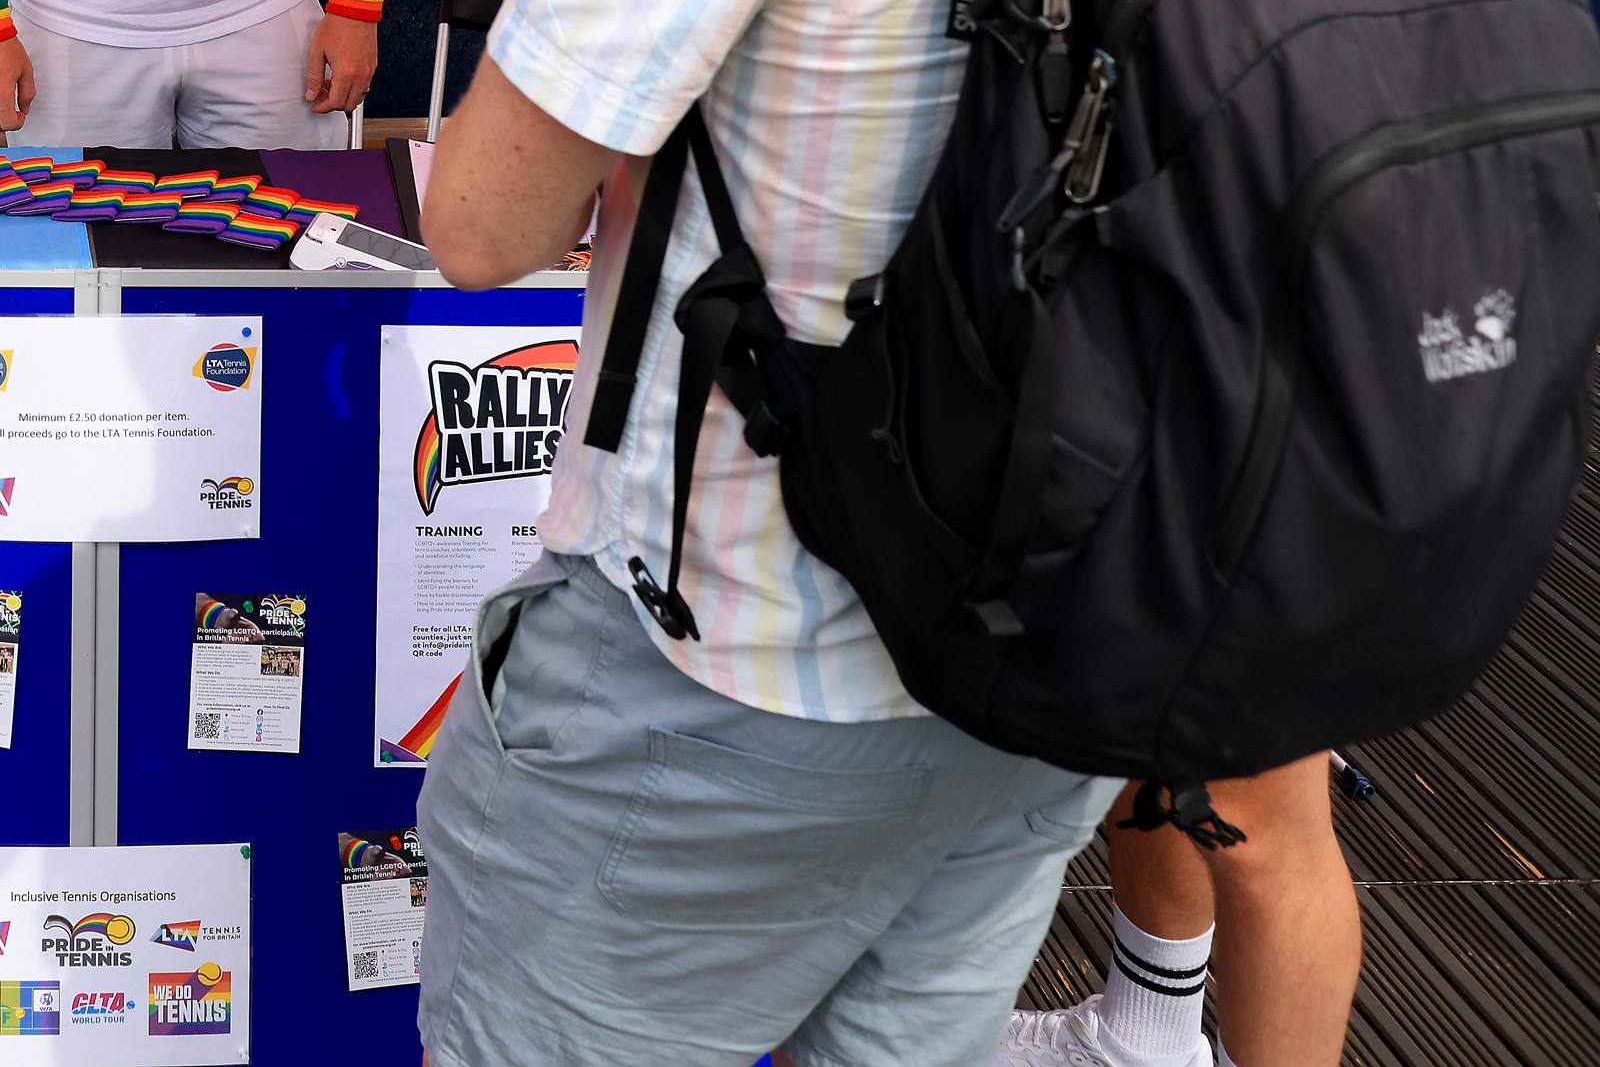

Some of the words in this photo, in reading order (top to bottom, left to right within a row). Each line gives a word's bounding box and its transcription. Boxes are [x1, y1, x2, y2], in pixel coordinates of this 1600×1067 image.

[206, 360, 224, 368] LTA
[223, 359, 247, 367] Tennis
[206, 367, 247, 375] Foundation
[438, 371, 572, 429] RALLY
[18, 412, 67, 422] Minimum
[69, 412, 96, 422] £2.50
[99, 411, 143, 422] donation
[145, 414, 163, 424] per
[165, 411, 190, 421] item.
[8, 428, 53, 440] proceeds
[55, 430, 68, 440] go
[70, 429, 81, 438] to
[83, 427, 100, 438] the
[102, 428, 120, 437] LTA
[123, 428, 155, 438] Tennis
[157, 427, 215, 437] Foundation.
[200, 491, 236, 501] PRIDE
[208, 499, 252, 509] TENNIS
[415, 526, 483, 536] TRAINING
[259, 609, 289, 617] PRIDE
[266, 617, 304, 625] TENNIS
[197, 627, 232, 635] Promoting
[261, 630, 304, 638] participation
[344, 865, 378, 873] Promoting
[352, 873, 374, 881] British
[11, 891, 59, 902] Inclusive
[62, 891, 97, 902] Tennis
[100, 890, 176, 904] Organisations
[163, 928, 198, 944] LTA
[202, 926, 241, 935] TENNIS
[42, 938, 103, 952] PRIDE
[56, 952, 133, 967] TENNIS
[153, 984, 172, 1000] WE
[174, 984, 192, 1000] DO
[72, 992, 125, 1014] GLTA
[155, 998, 228, 1024] TENNIS
